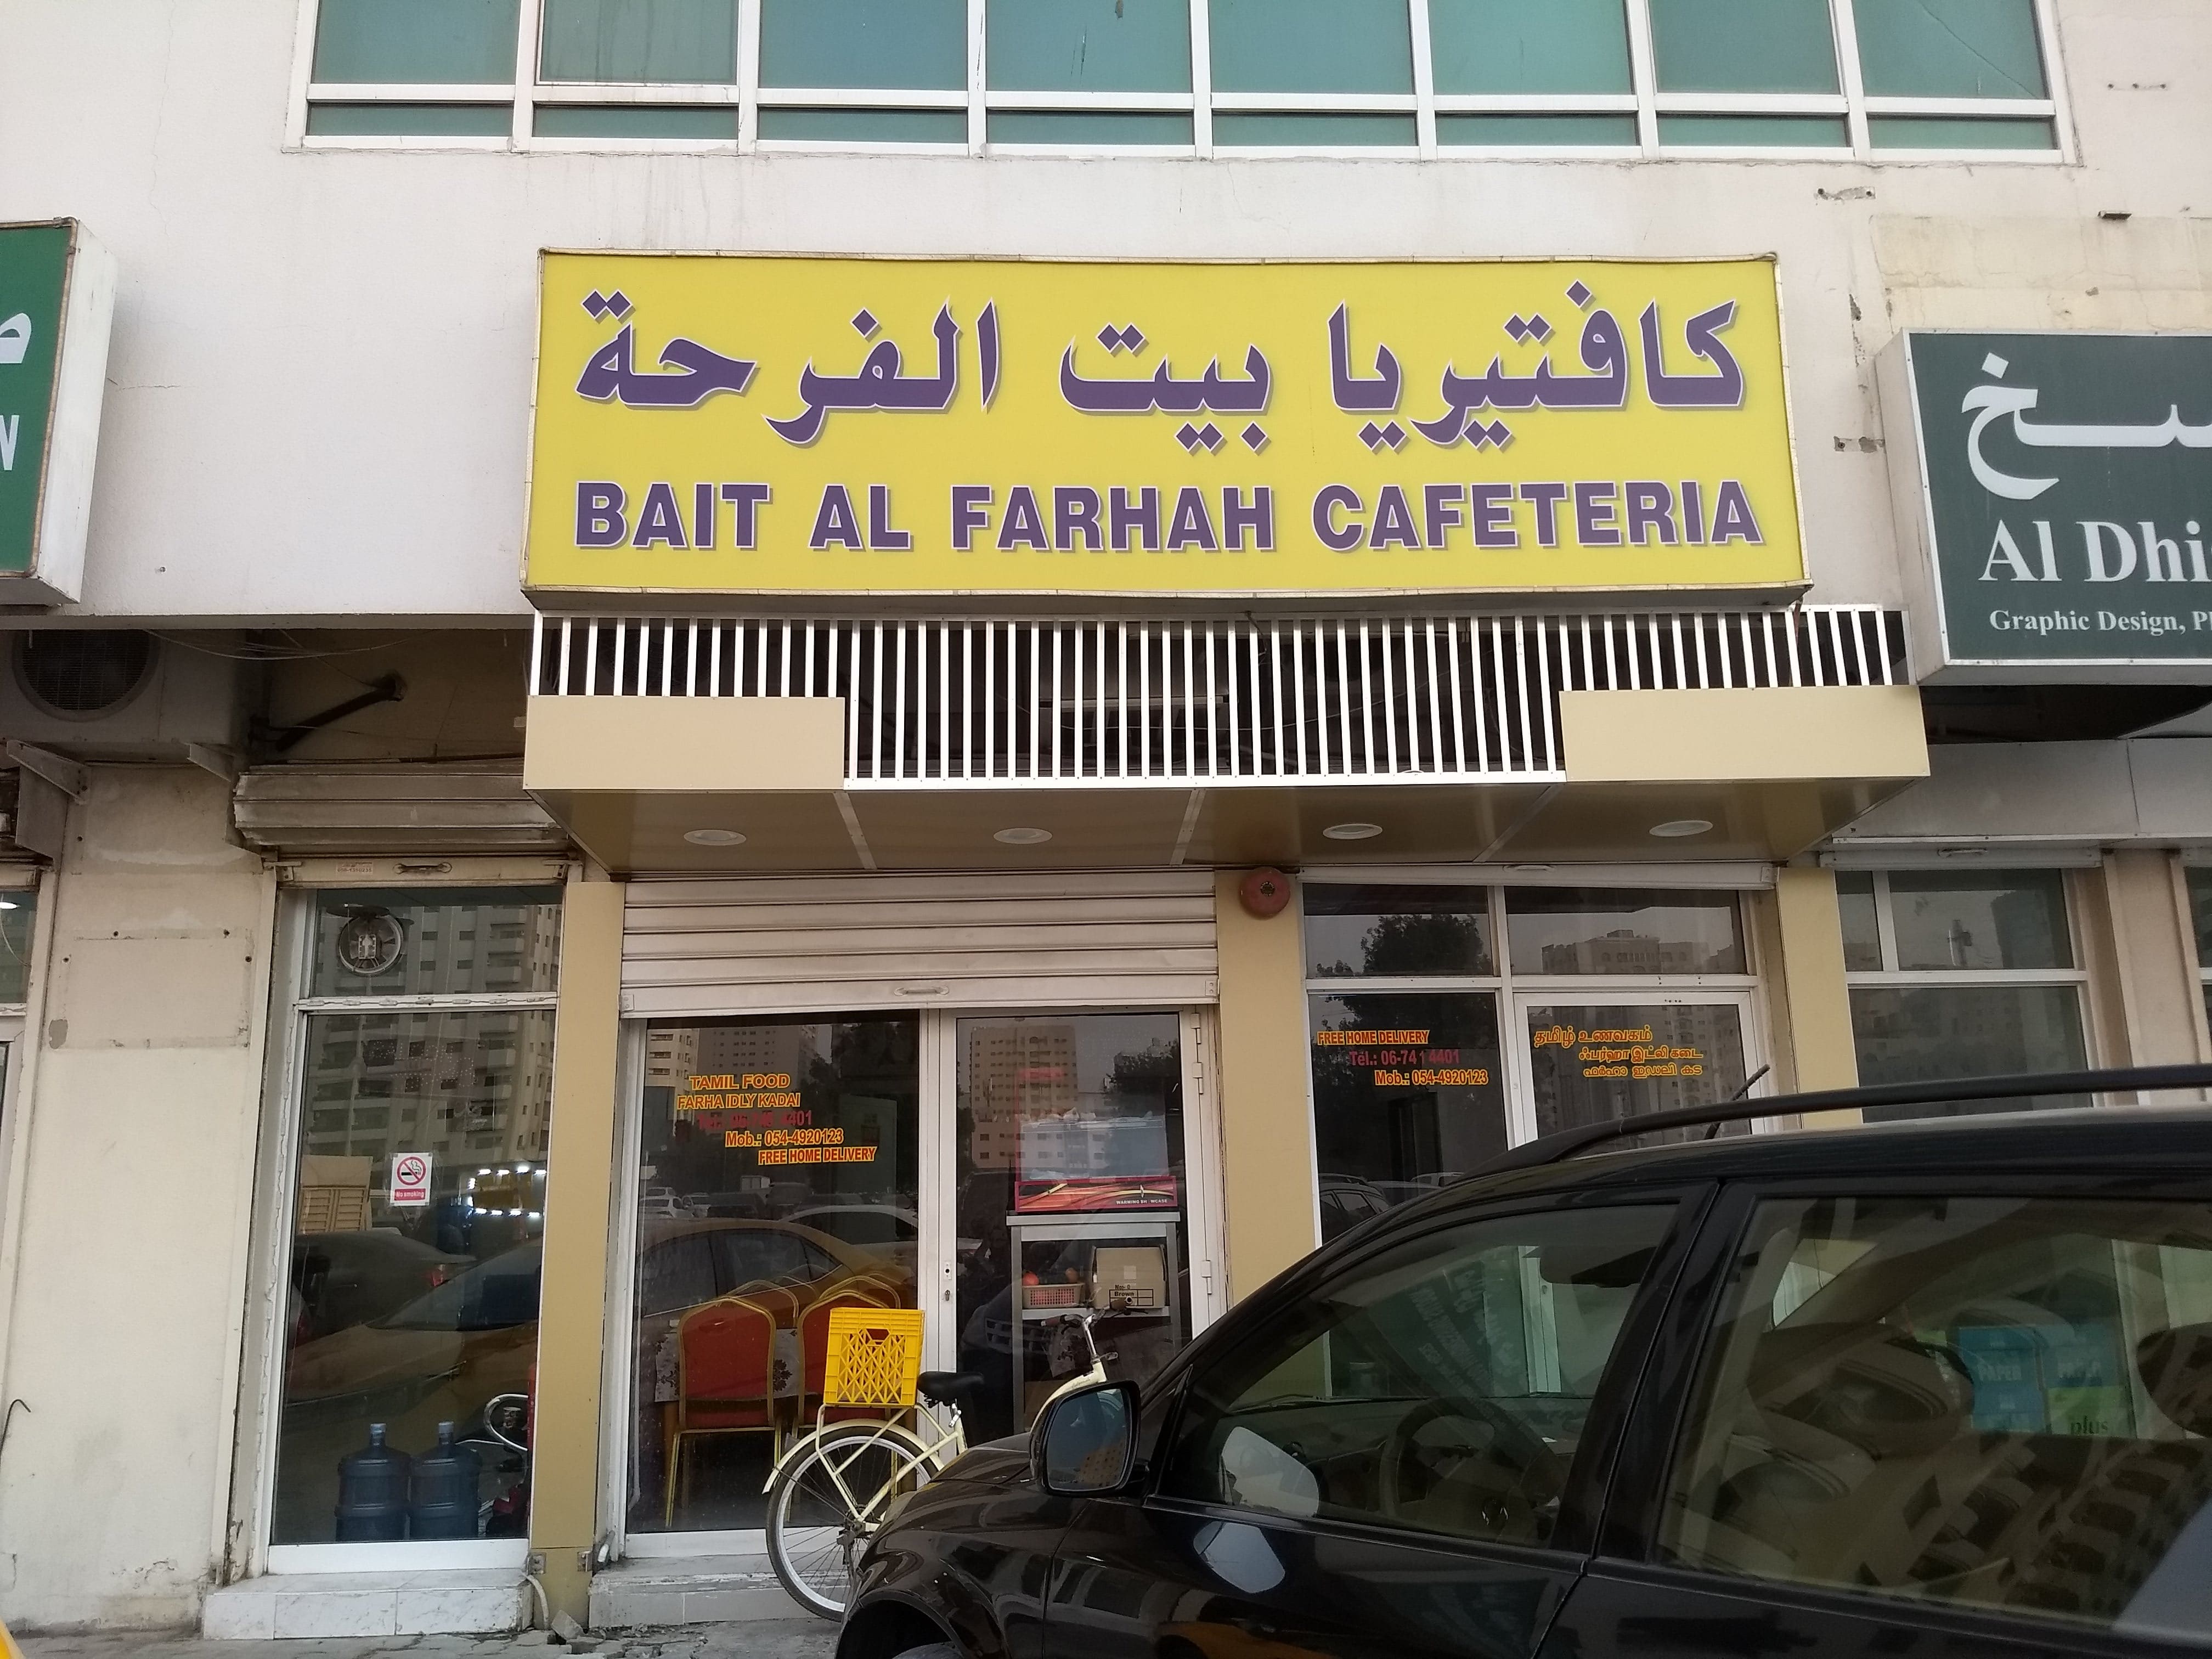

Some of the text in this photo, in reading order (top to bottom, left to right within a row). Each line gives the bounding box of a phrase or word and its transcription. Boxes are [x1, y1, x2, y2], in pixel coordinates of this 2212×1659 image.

[574, 280, 1743, 452] كافتيريا بيت الفرحة
[575, 480, 1763, 551] BAIT AL FARHAH CAFETERIA
[1978, 520, 2212, 582] Al Dhi
[1990, 610, 2090, 635] Graphic
[2098, 611, 2186, 635] Design,
[1317, 1030, 1430, 1045] FREE HOME DELIVERY
[1534, 1024, 1653, 1048] தமிழ் உணவகம்
[689, 1074, 790, 1091] TAMIL FOOD
[1375, 1069, 1488, 1085] Mob.: 054-4920123
[677, 1093, 801, 1110] FARHA IDLY KADAI
[725, 1128, 844, 1147] Mob.: 054-4920123
[758, 1147, 877, 1165] FREE HOME DELIVERY
